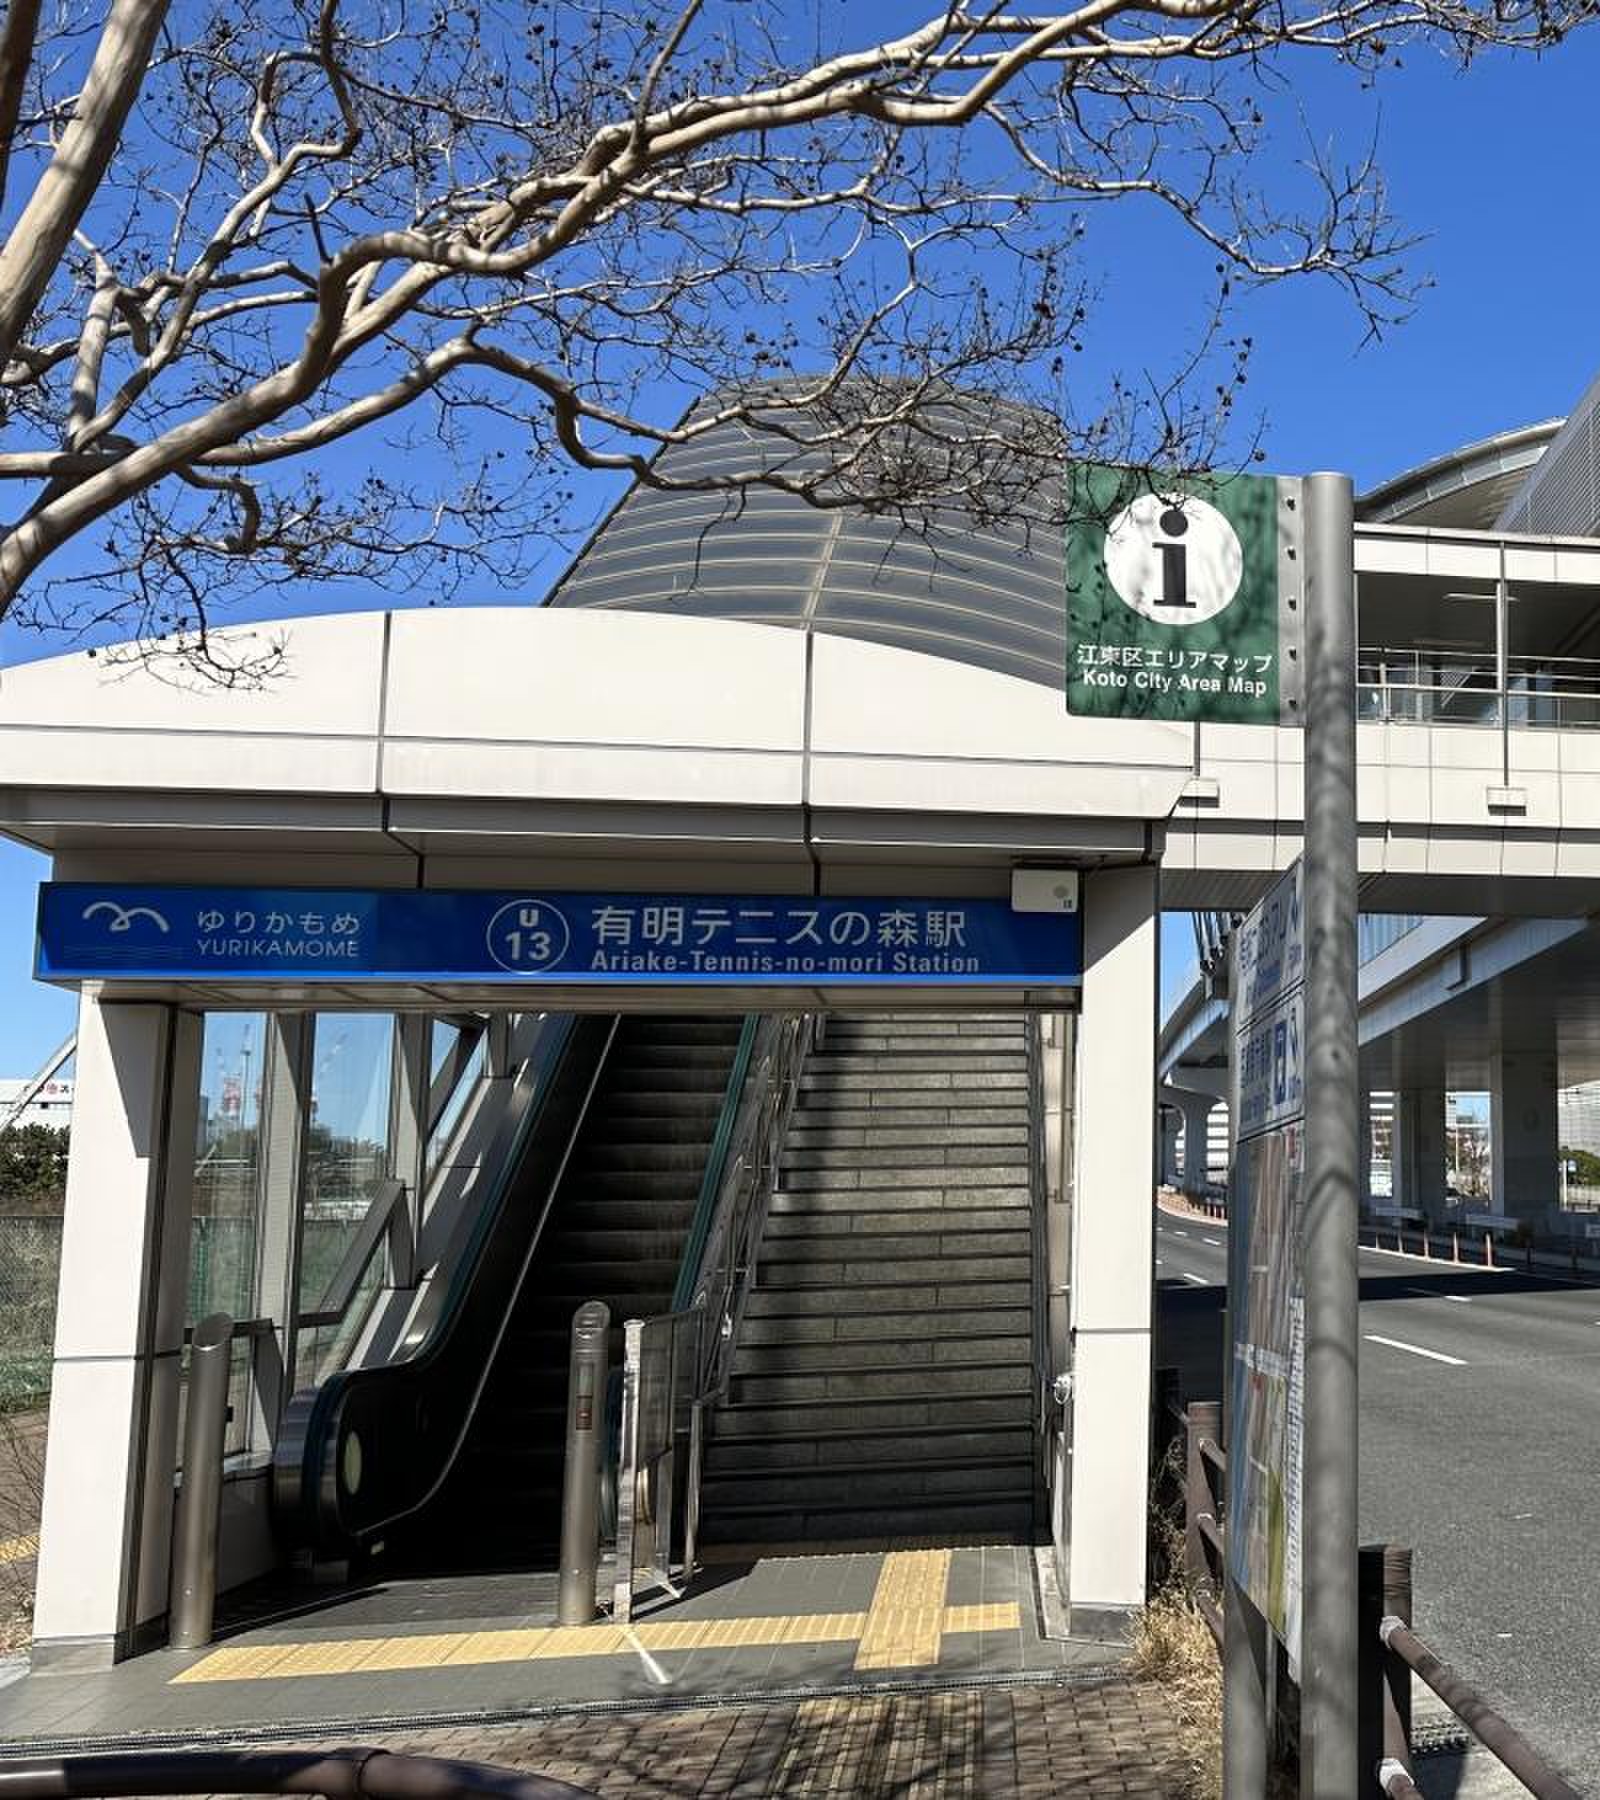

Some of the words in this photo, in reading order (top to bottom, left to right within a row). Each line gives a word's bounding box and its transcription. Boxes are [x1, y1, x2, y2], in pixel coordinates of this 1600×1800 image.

[1077, 643, 1273, 674] 江東区エリアマップ
[1083, 668, 1128, 689] Koto
[1135, 671, 1173, 694] City
[1178, 673, 1221, 693] Area
[1227, 676, 1267, 698] Map
[197, 909, 361, 935] ゆりかもめ
[520, 909, 539, 928] U
[590, 905, 968, 949] 有明テニスの森駅
[198, 938, 360, 959] YURIKAMOME
[505, 931, 552, 962] 13
[590, 951, 884, 973] Ariake-Tennis-no-mori
[893, 952, 980, 974] Station
